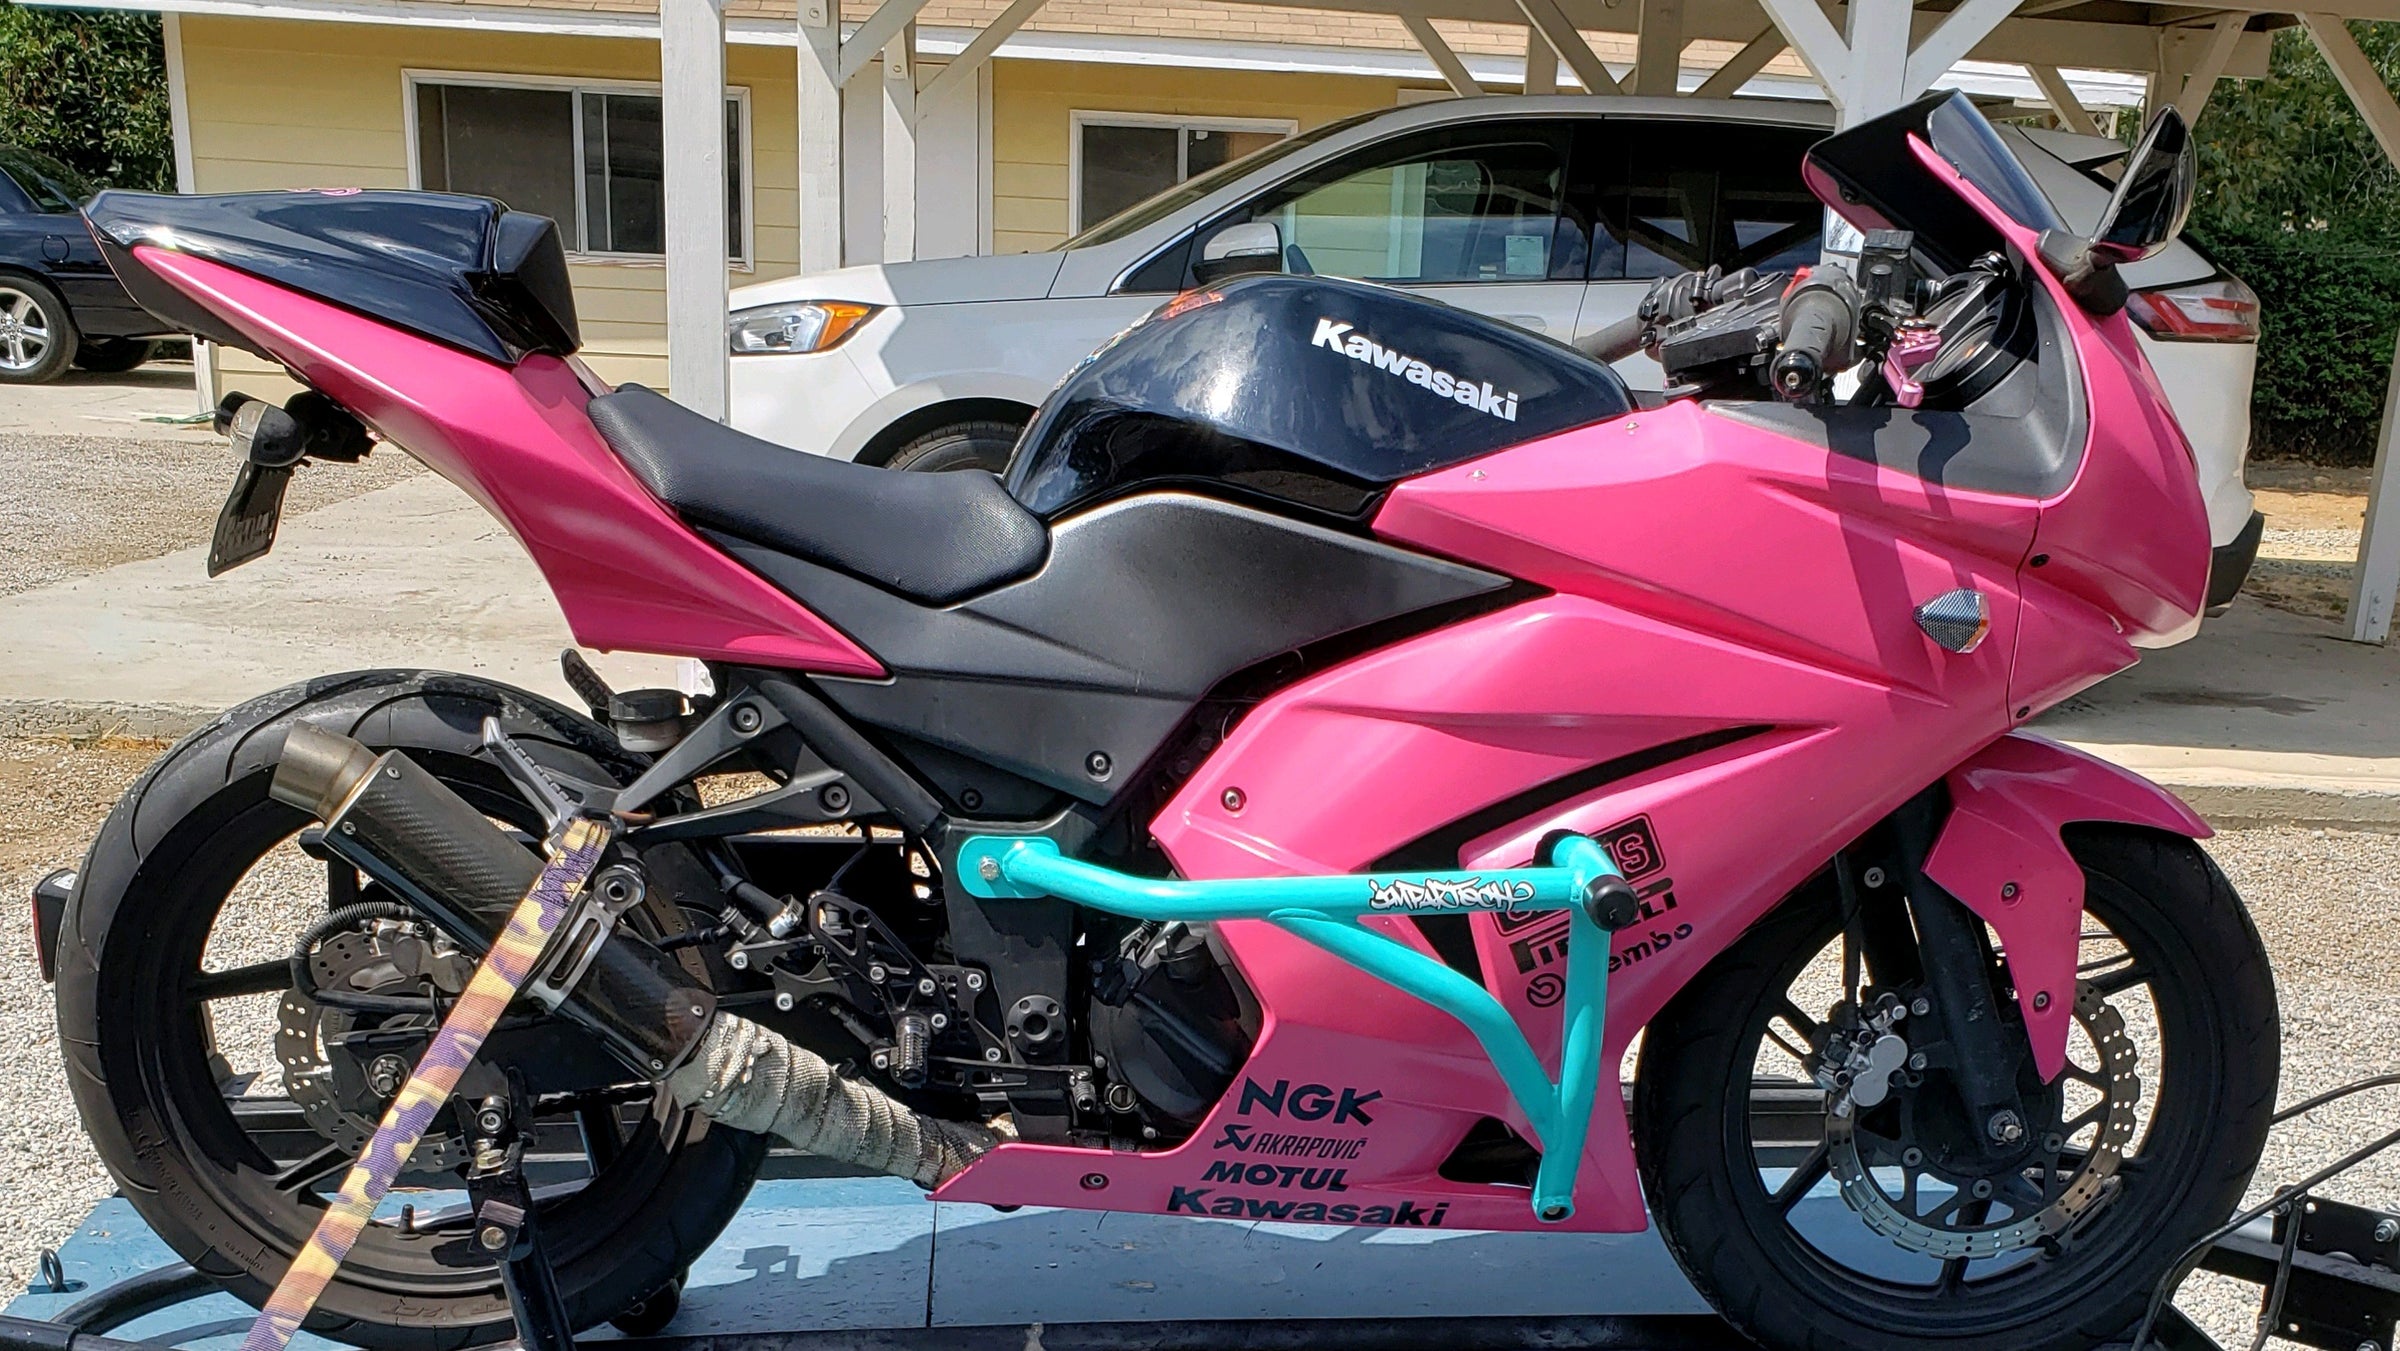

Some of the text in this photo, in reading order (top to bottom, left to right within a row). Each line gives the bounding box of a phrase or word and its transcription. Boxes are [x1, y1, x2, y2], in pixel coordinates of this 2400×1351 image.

[1311, 318, 1519, 422] Kawasaki
[1237, 1076, 1383, 1127] NGK
[1201, 1161, 1349, 1192] MOTUL
[1167, 1186, 1450, 1227] Kawasaki
